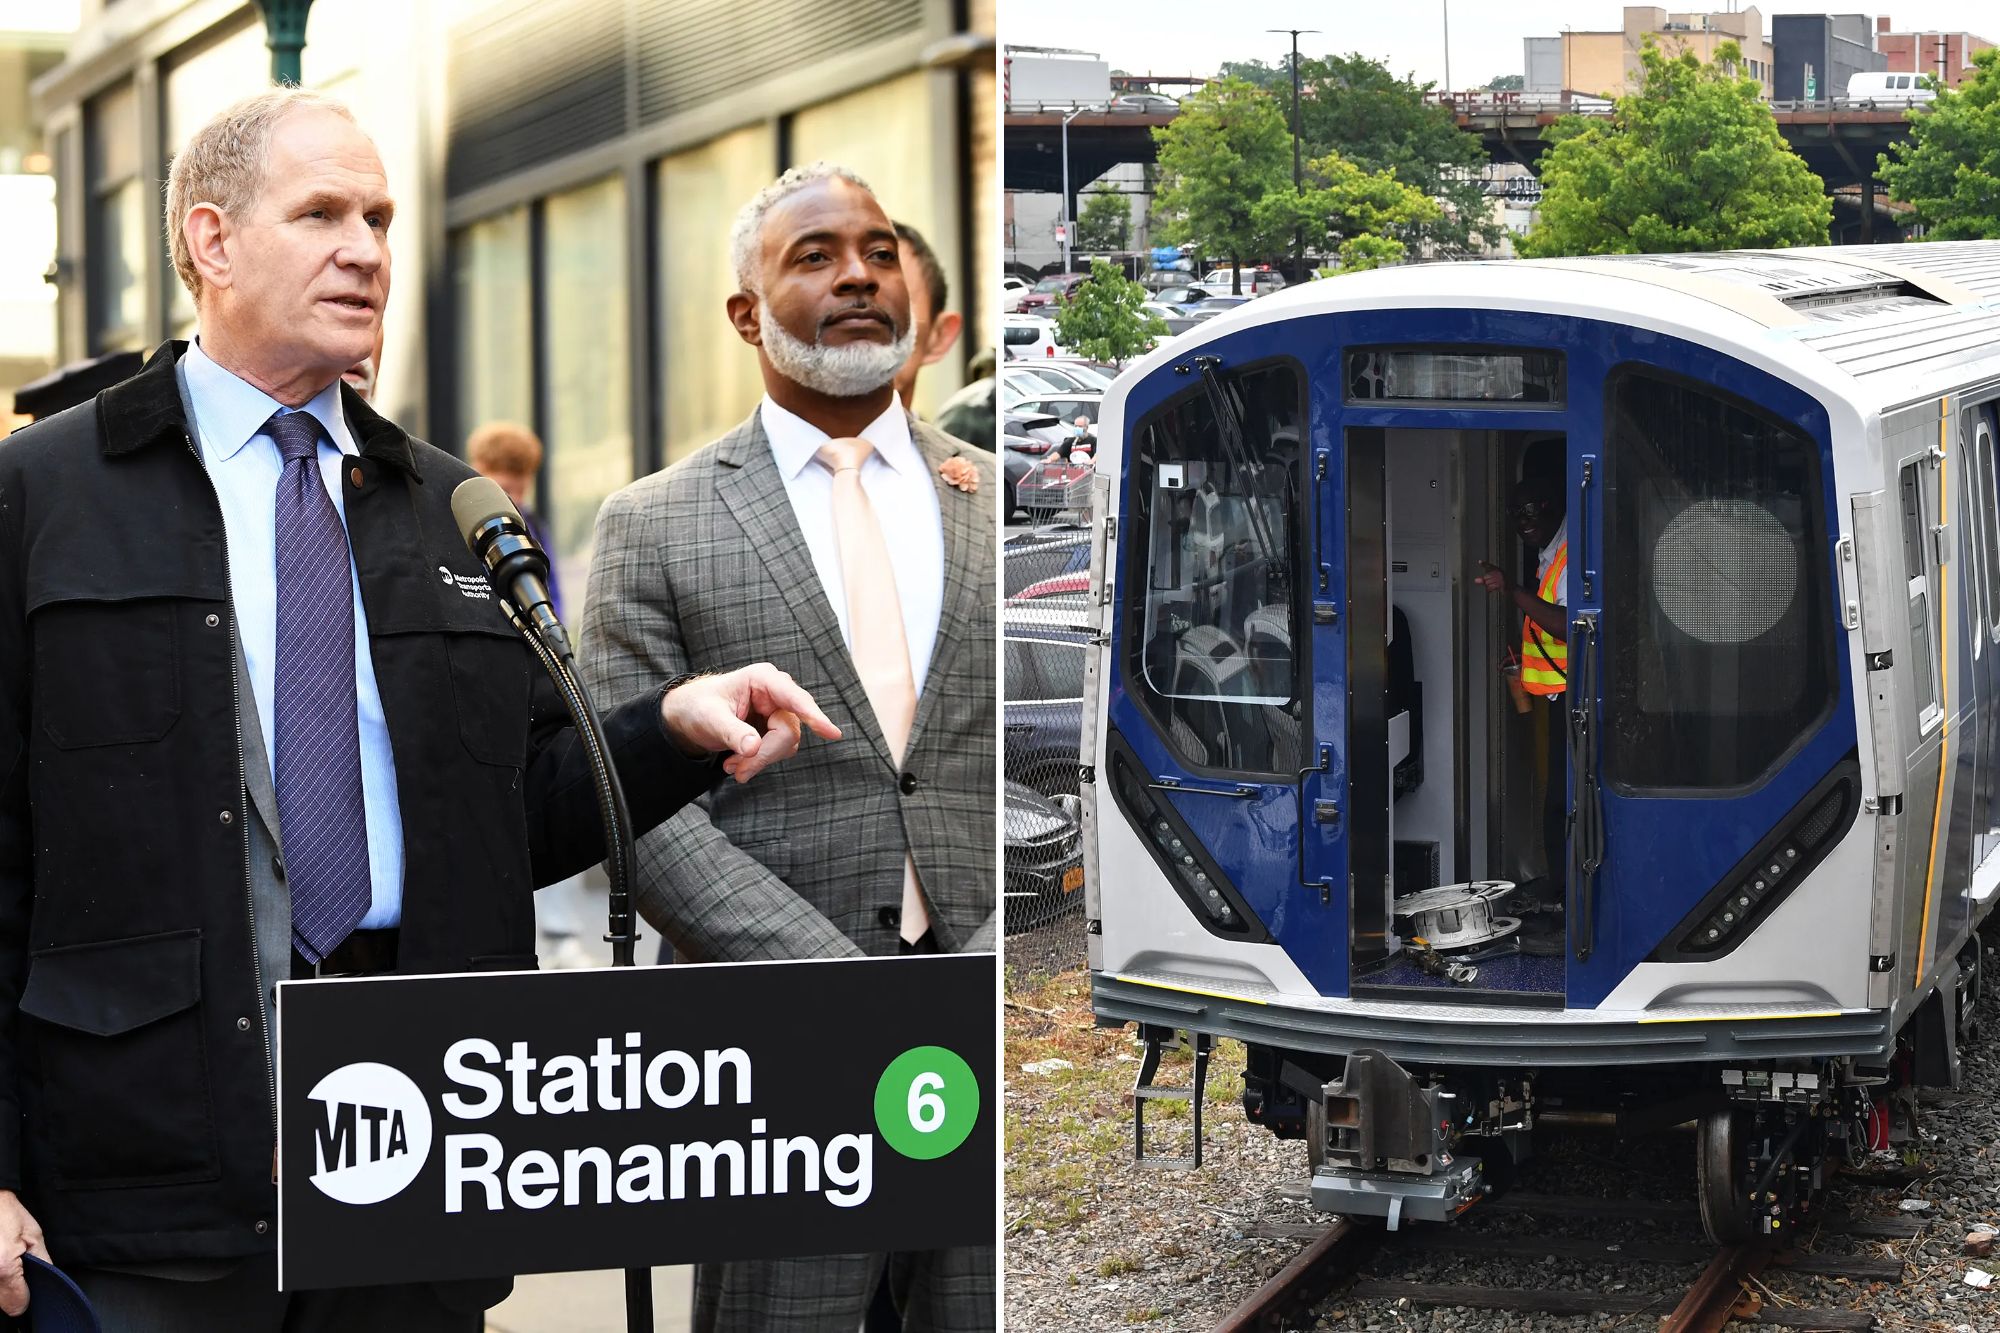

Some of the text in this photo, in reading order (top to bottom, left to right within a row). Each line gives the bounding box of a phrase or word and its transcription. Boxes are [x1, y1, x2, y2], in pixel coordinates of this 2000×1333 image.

[441, 1031, 752, 1120] Station
[907, 1071, 946, 1133] 6
[307, 1098, 409, 1176] MTA
[444, 1118, 873, 1213] Renaming
